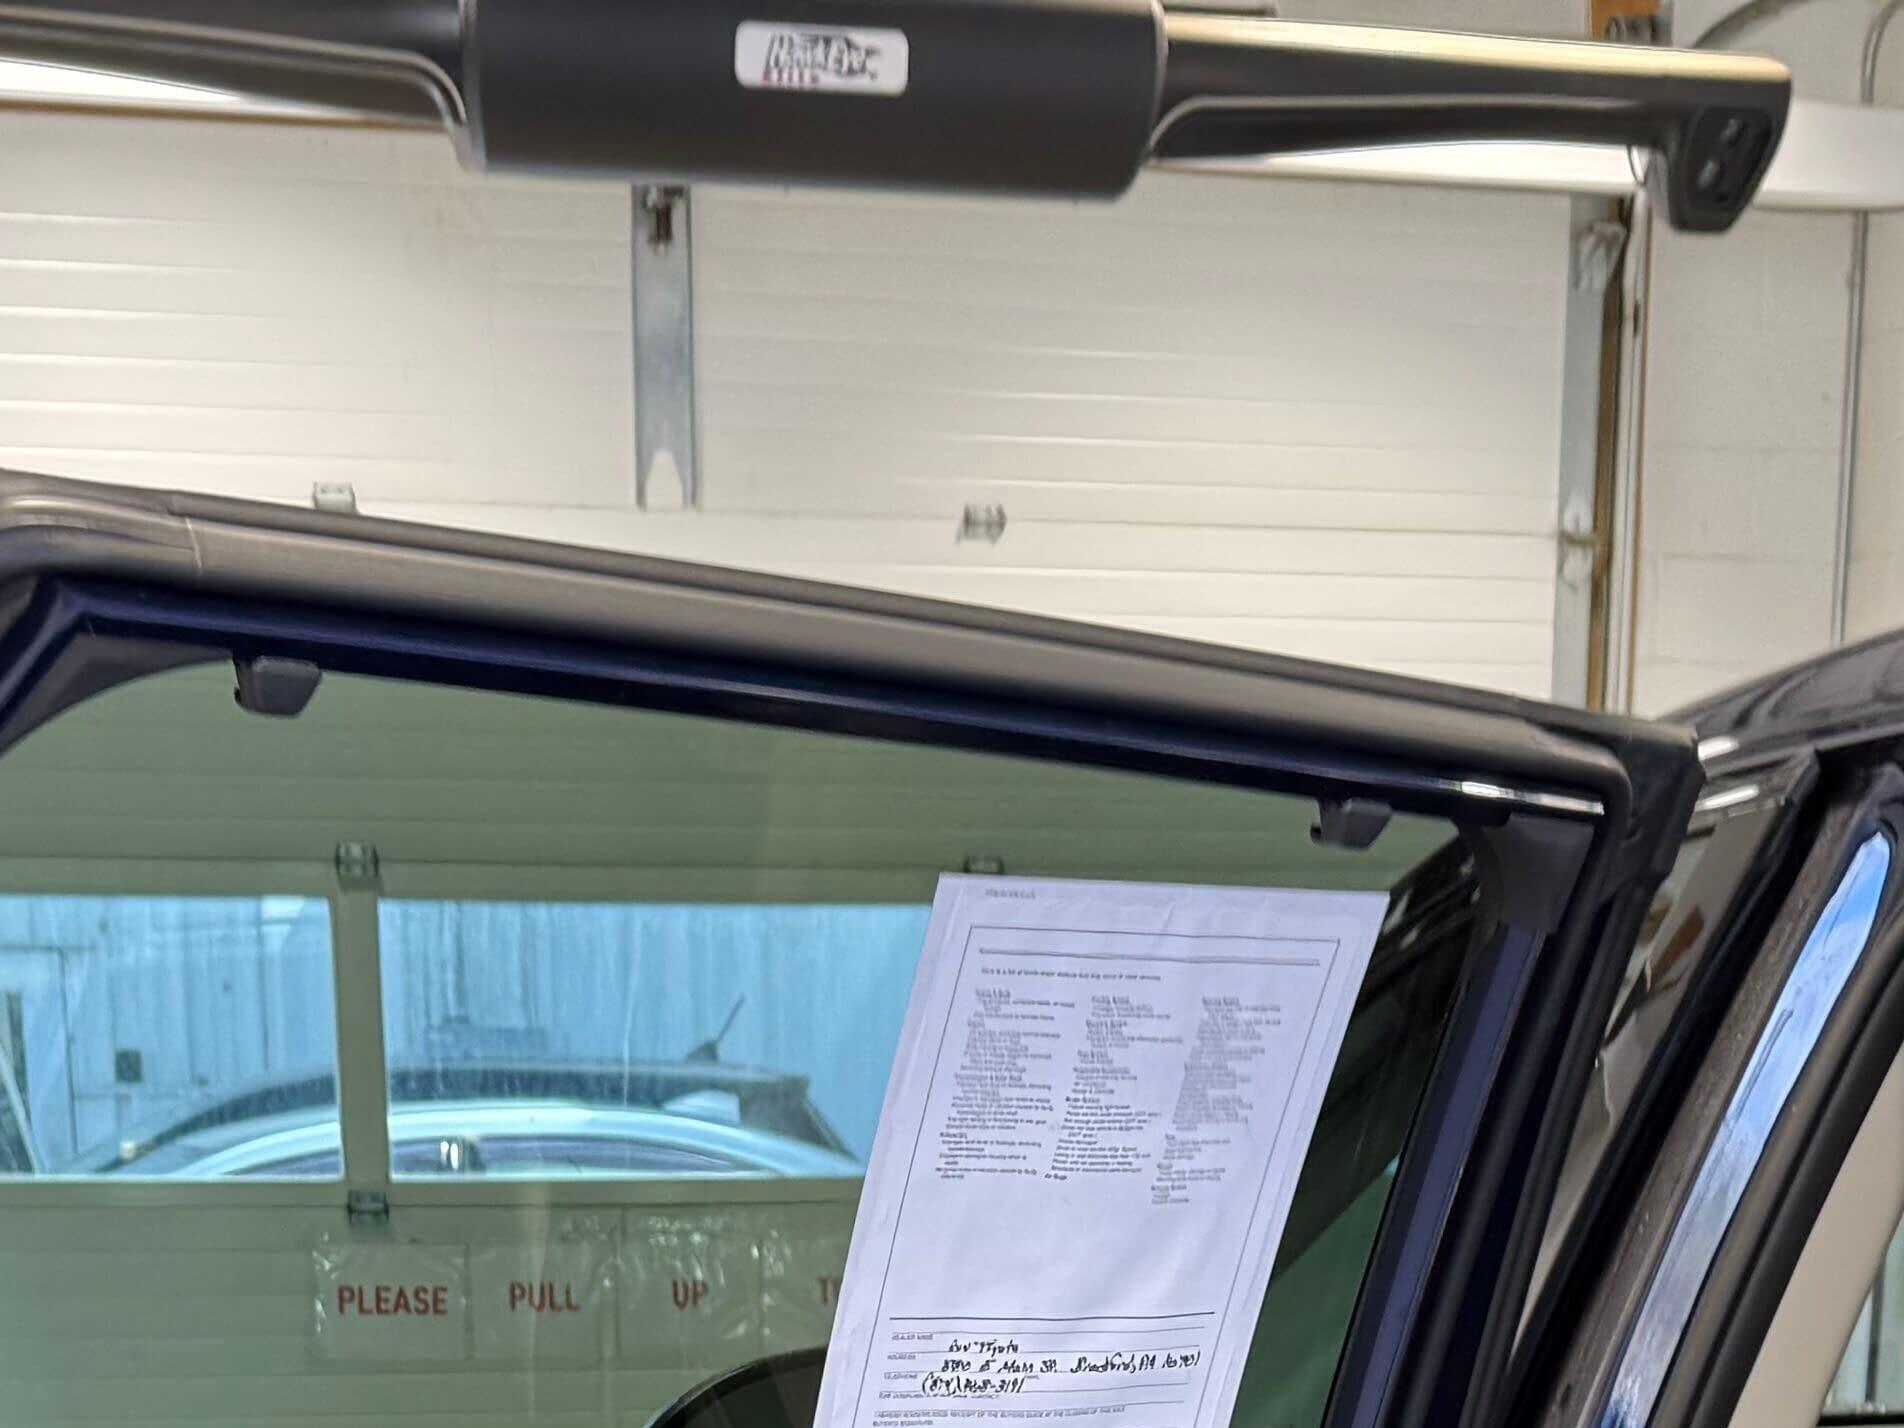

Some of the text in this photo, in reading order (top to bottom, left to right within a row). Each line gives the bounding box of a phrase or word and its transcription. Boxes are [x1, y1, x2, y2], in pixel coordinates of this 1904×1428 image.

[337, 1285, 448, 1315] PLEASE
[508, 1281, 581, 1312] PULL
[671, 1279, 710, 1309] UP
